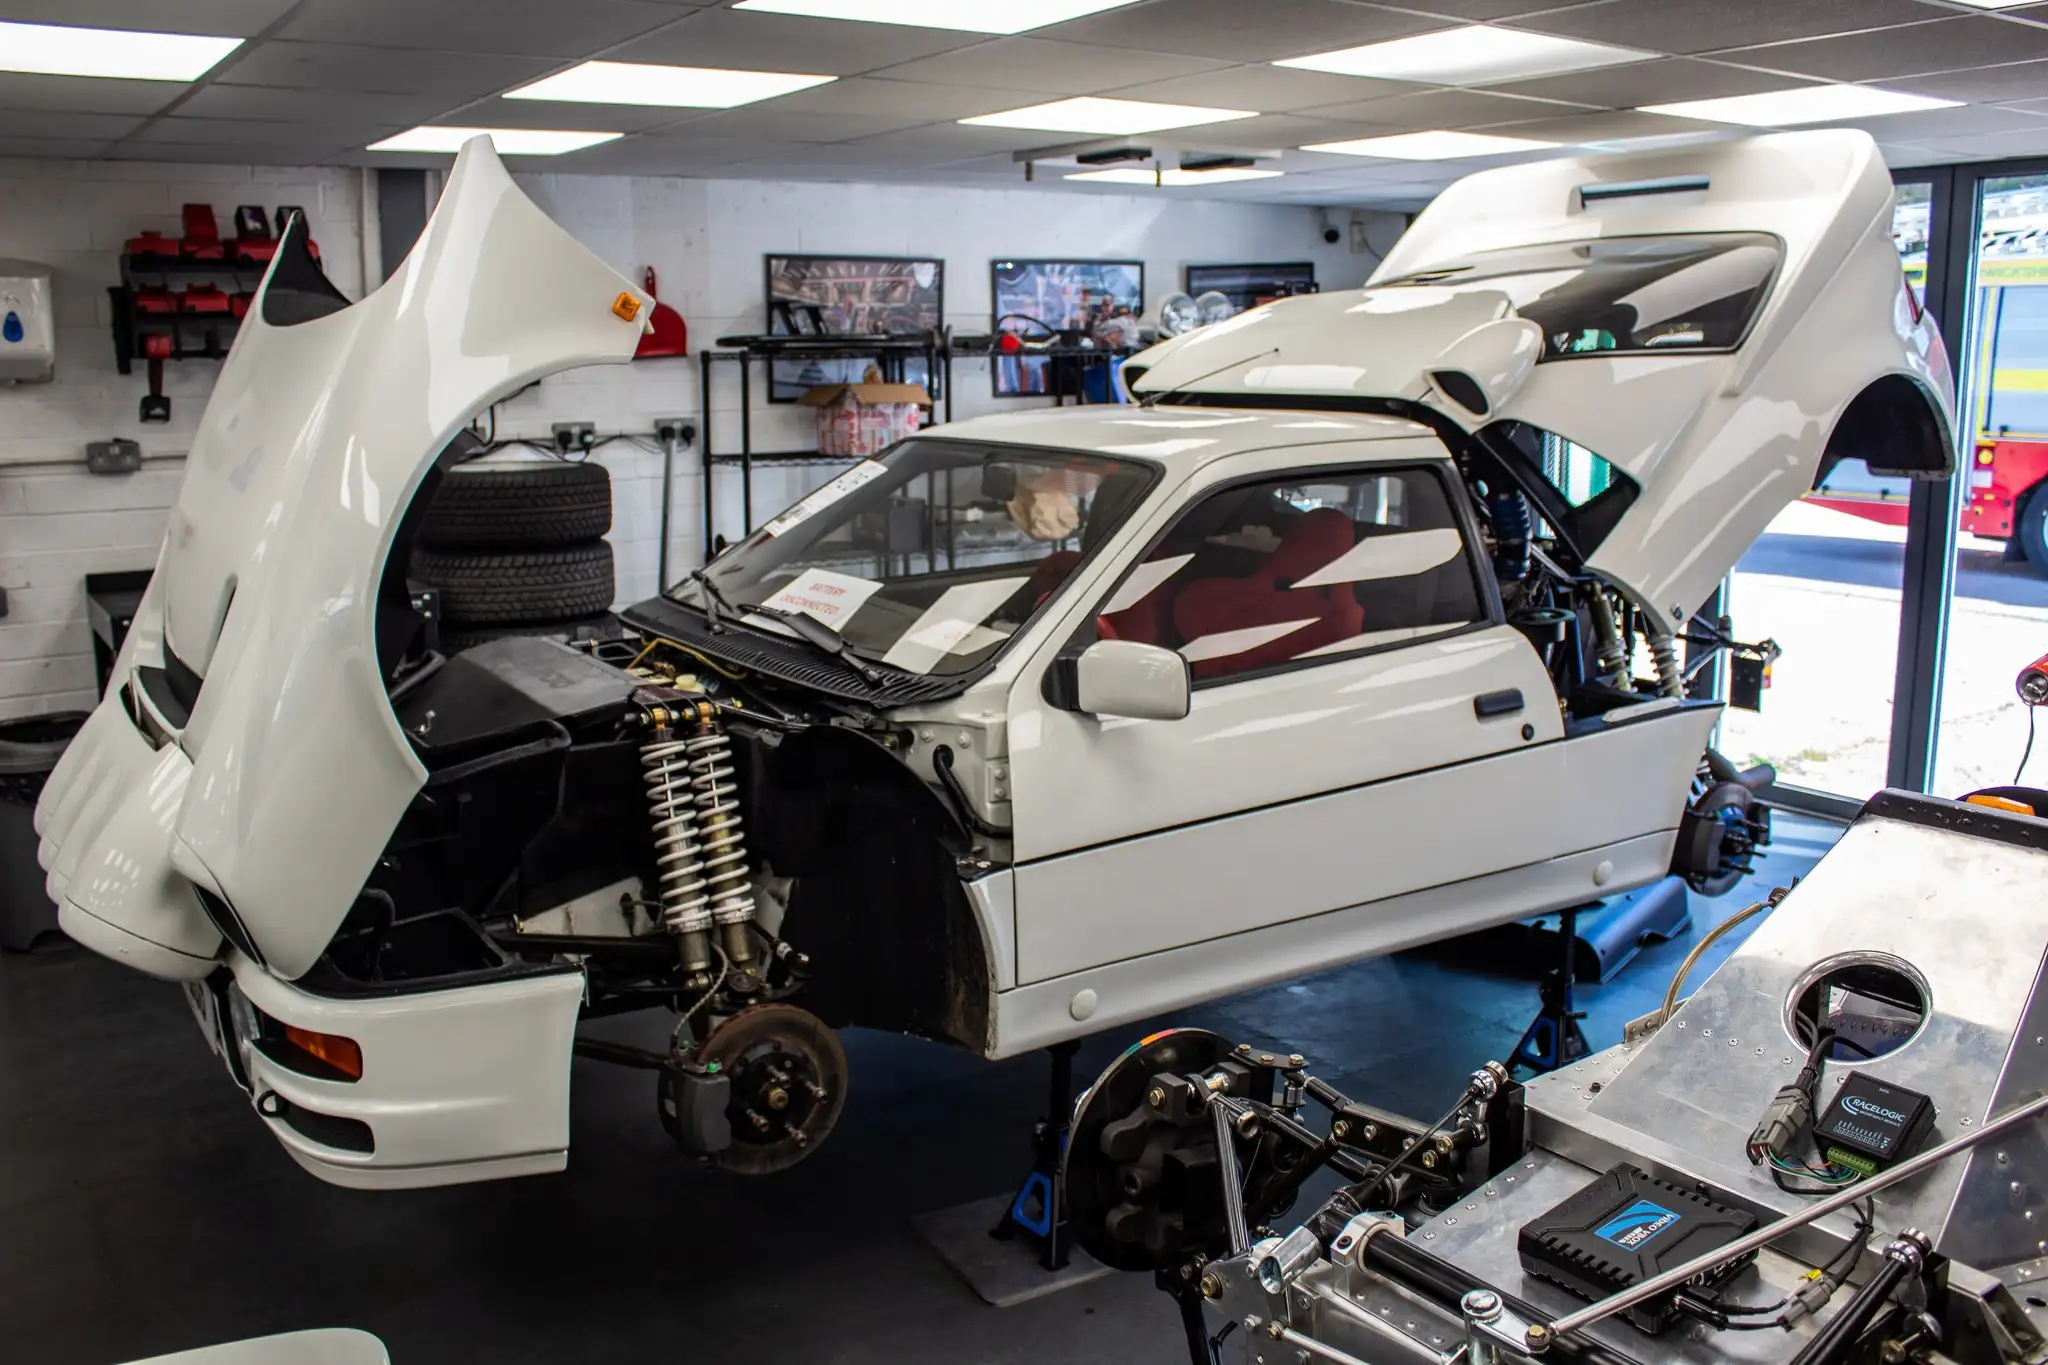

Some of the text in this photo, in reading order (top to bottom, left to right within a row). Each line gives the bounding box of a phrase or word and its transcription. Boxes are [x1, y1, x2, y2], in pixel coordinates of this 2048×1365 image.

[809, 583, 847, 596] BATTERY
[779, 594, 839, 614] DISCONNECTED
[1852, 1099, 1905, 1122] RACELOGIC
[1884, 1118, 1901, 1127] MODULE
[1648, 1213, 1675, 1231] VIDEO
[1626, 1229, 1651, 1246] VBOX
